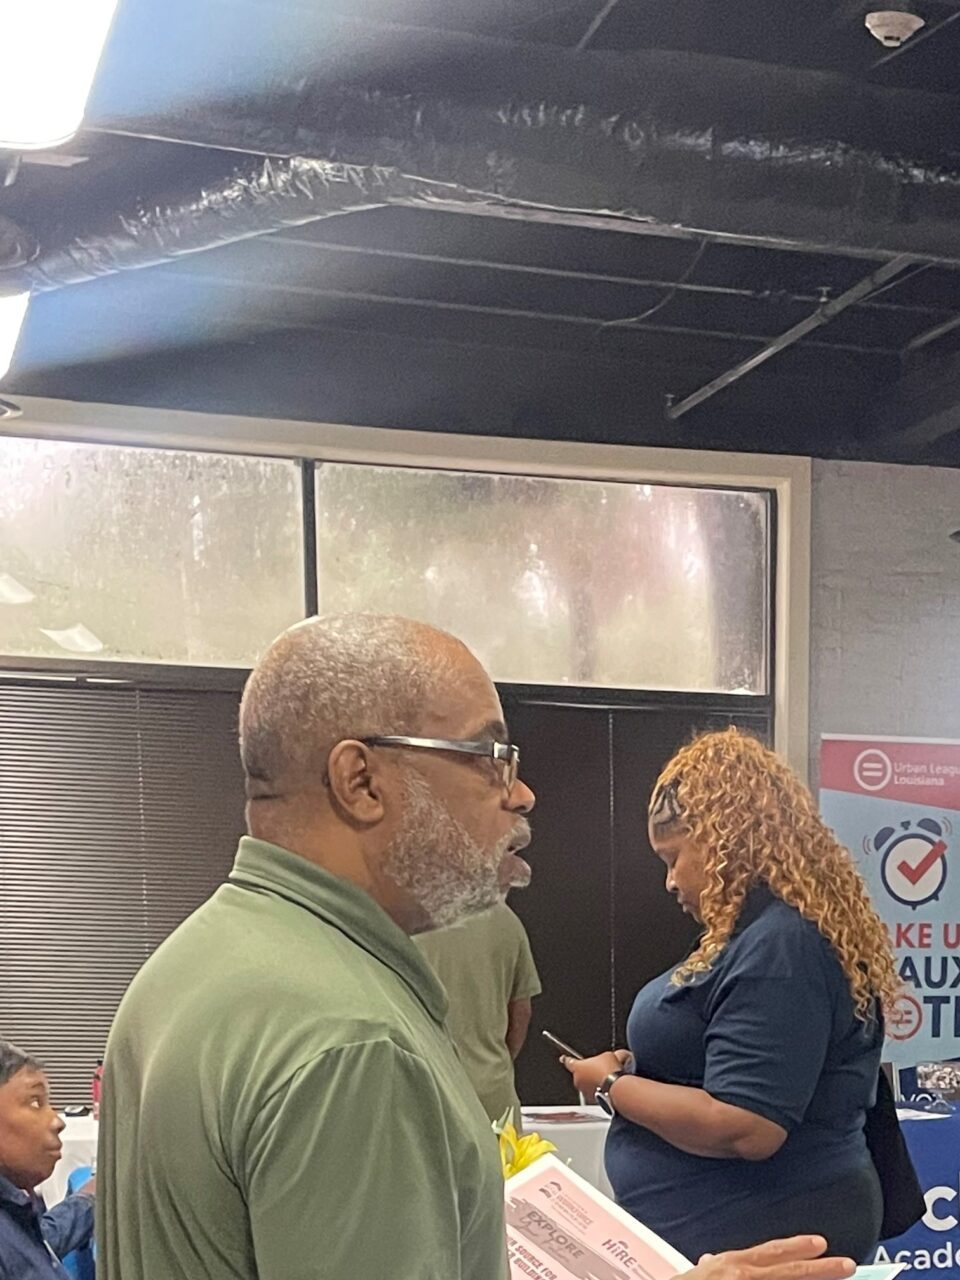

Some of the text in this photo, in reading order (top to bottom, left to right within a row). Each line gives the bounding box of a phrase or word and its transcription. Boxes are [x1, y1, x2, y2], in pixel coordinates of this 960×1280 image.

[893, 761, 927, 773] Urban
[893, 775, 945, 786] Louisiana
[894, 923, 933, 949] KE
[527, 1211, 585, 1260] EXPLORE
